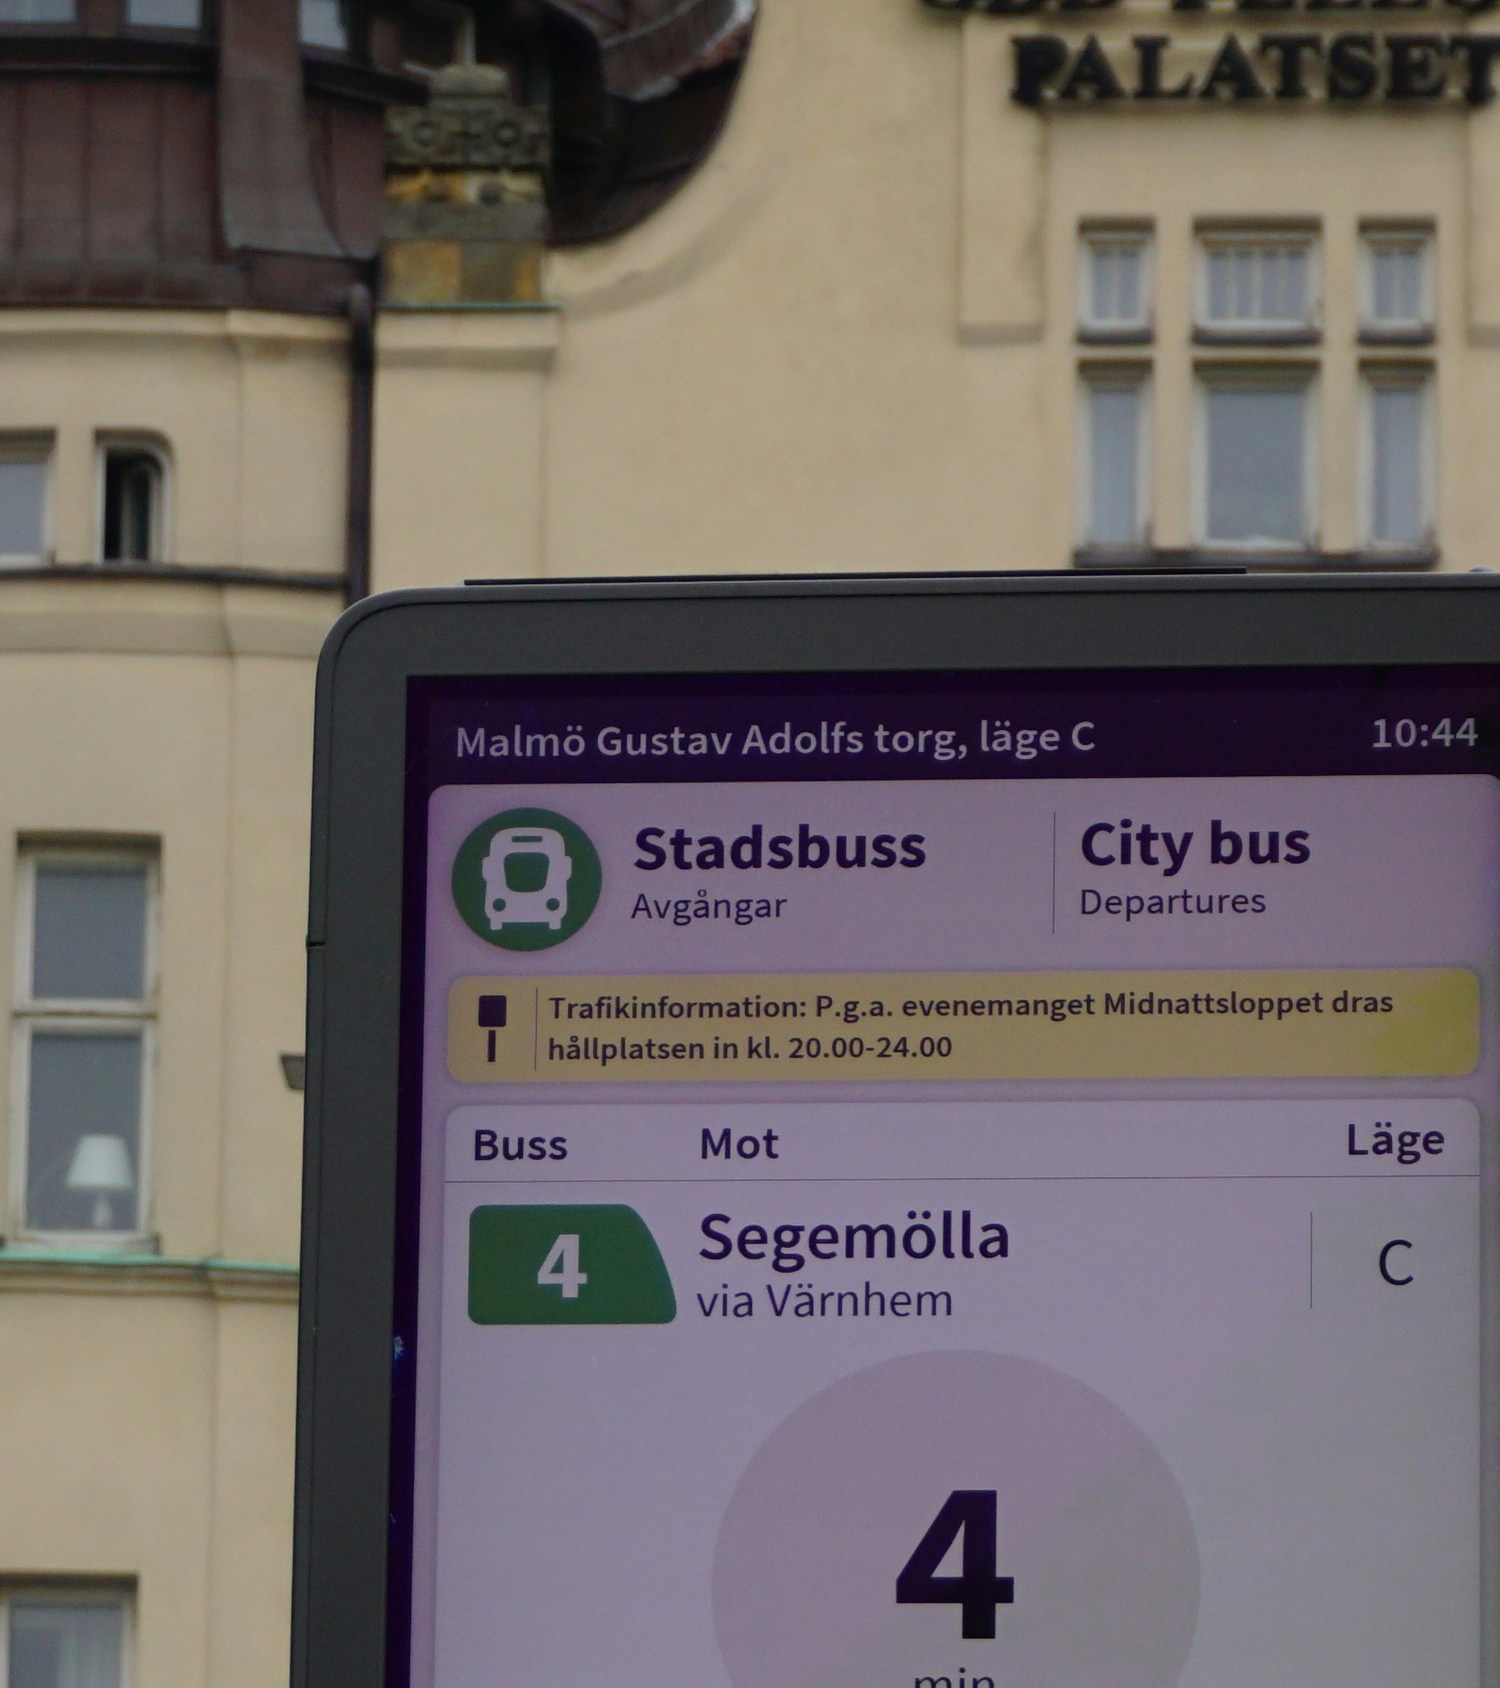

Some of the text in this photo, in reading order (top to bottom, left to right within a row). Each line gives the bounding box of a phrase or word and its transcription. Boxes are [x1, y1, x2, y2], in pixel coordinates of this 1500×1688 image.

[457, 719, 1095, 761] Malmö Gustav Adolfs torg, läge C
[1372, 717, 1478, 748] 10:44
[633, 823, 926, 871] Stadsbuss
[1081, 818, 1311, 877] City bus
[630, 889, 788, 927] Avgångar
[1080, 889, 1266, 922] Departures
[548, 989, 1394, 1024] Trafikinformation: P.g.a. evenemanget Midnattsloppet dras
[548, 1035, 953, 1067] hållplatsen in kl. 20.00-24.00
[474, 1129, 568, 1161] Buss
[701, 1127, 779, 1160] Mot
[1348, 1121, 1445, 1165] Läge
[699, 1209, 1009, 1274] Segemölla
[537, 1233, 588, 1299] 4
[1378, 1239, 1414, 1286] C
[696, 1280, 952, 1318] via Värnhem
[895, 1489, 1015, 1640] 4
